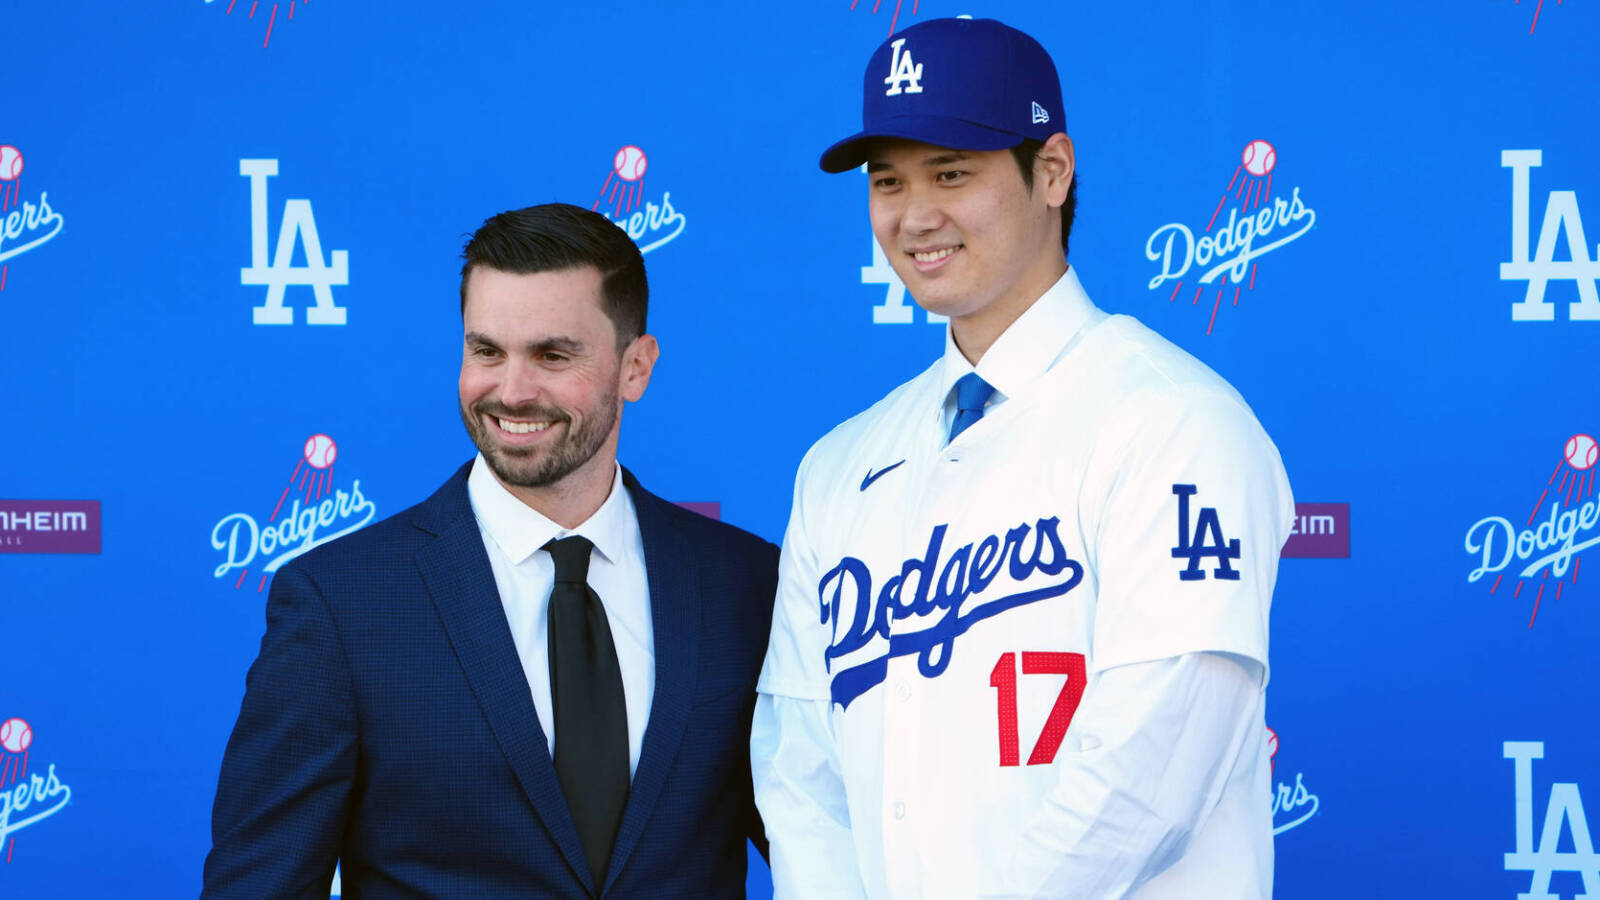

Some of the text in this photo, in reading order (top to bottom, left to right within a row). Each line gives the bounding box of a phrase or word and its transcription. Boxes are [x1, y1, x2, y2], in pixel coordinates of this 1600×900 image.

[884, 38, 924, 96] LA
[0, 191, 63, 262] ers
[239, 158, 349, 325] LA
[1145, 186, 1316, 290] Dodgers
[1500, 148, 1600, 321] LA
[211, 479, 376, 578] Dodgers
[1171, 483, 1241, 581] LA
[1465, 492, 1600, 583] Dodge
[818, 515, 1084, 713] Dodgers
[989, 650, 1088, 768] 17
[1503, 741, 1600, 900] LA
